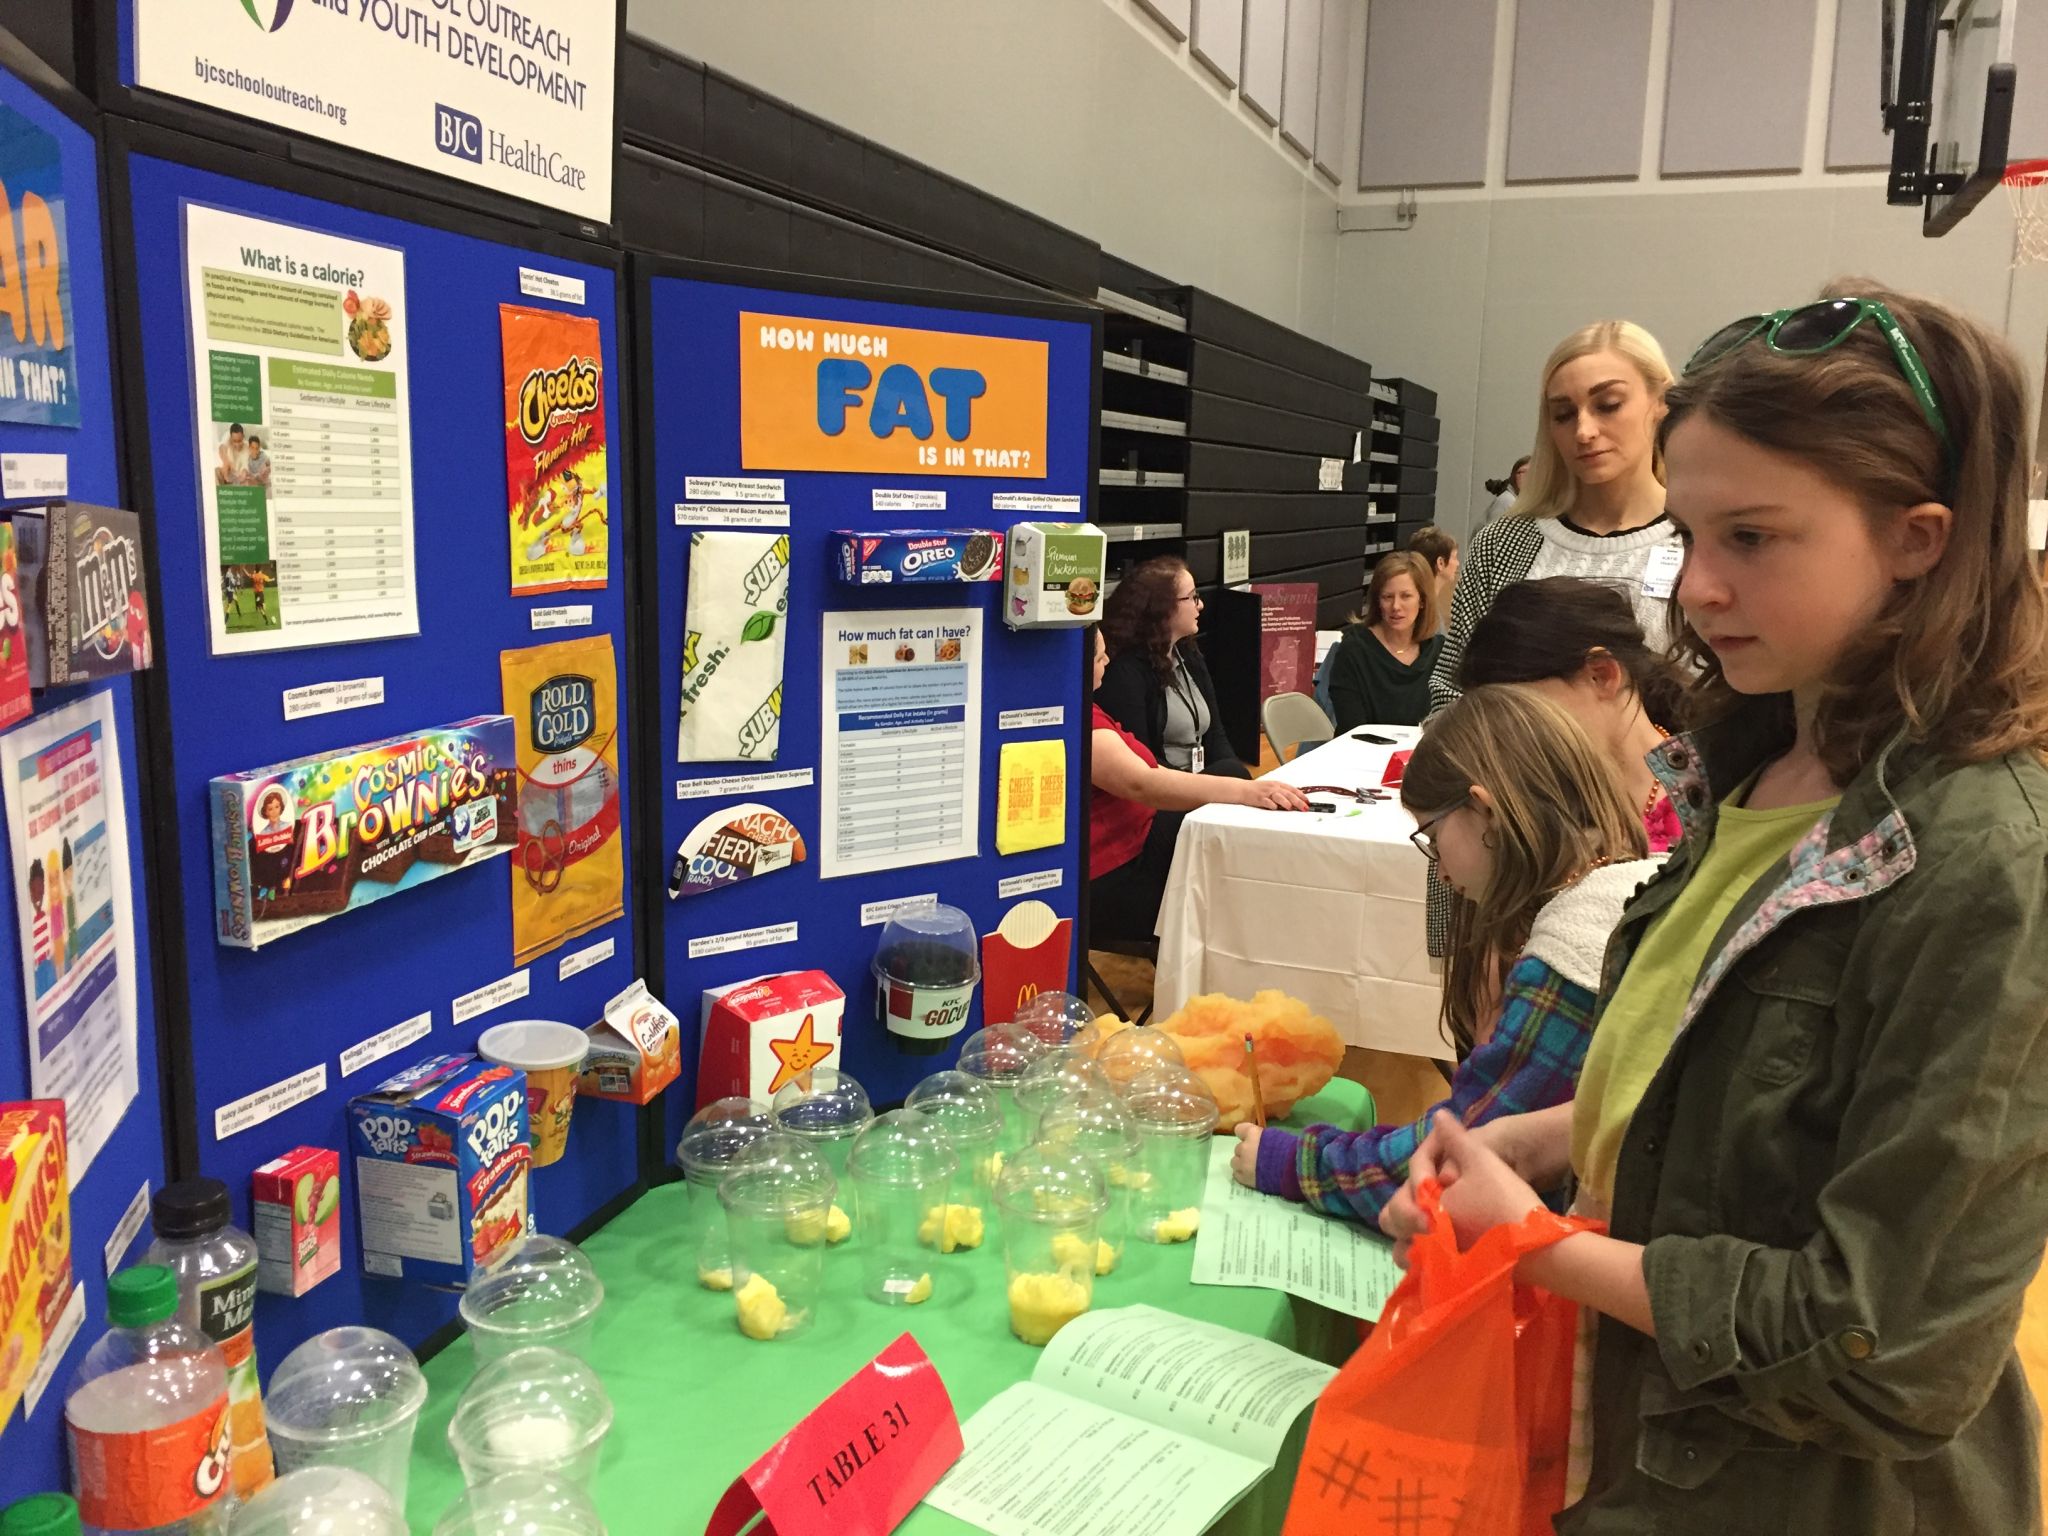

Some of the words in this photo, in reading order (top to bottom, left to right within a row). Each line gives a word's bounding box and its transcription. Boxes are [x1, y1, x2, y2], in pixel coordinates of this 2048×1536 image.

[467, 0, 571, 66] OUTREACH
[359, 0, 440, 53] YOUTH
[447, 25, 587, 111] DEVELOPMENT
[194, 56, 348, 126] bjcschooloutreach.org
[439, 110, 478, 156] BJC
[488, 128, 586, 191] HealthCare
[240, 246, 282, 274] What
[285, 255, 297, 276] is
[300, 263, 309, 277] a
[312, 263, 365, 288] calorie?
[760, 326, 814, 352] HOW
[823, 331, 888, 358] MUCH
[19, 359, 67, 406] THAT?
[520, 356, 597, 442] Cheetos
[817, 357, 987, 442] FAT
[571, 421, 592, 447] Hot
[919, 446, 938, 466] IS
[945, 447, 965, 467] IN
[973, 447, 1031, 469] THAT?
[689, 479, 710, 487] Subway
[720, 480, 737, 489] Turkey
[756, 483, 782, 491] Sandwich
[677, 505, 698, 513] Subway
[903, 547, 955, 570] OREO
[907, 540, 932, 551] Double
[932, 538, 947, 547] Stuf
[838, 629, 863, 642] How
[867, 628, 896, 640] much
[899, 627, 913, 640] fat
[916, 629, 934, 639] can
[942, 625, 971, 638] have?
[681, 647, 730, 704] fresh.
[308, 686, 335, 697] Brownies
[540, 681, 585, 713] ROLD
[538, 705, 589, 746] GOLD
[552, 758, 577, 775] thins
[679, 781, 691, 789] Taco
[721, 777, 740, 785] Cheese
[568, 825, 601, 855] Original
[734, 813, 801, 841] NACHO
[746, 831, 778, 844] CHEESE
[361, 838, 413, 873] CHOCOLATE
[413, 829, 428, 845] CHIP
[428, 821, 446, 836] CANDY
[702, 833, 763, 865] FIERY
[687, 874, 713, 885] RANCH
[688, 854, 739, 881] COOL
[367, 1039, 378, 1049] Pop
[221, 1109, 237, 1122] Juicy
[237, 1102, 253, 1114] Juice
[271, 1086, 287, 1098] Juice
[287, 1079, 302, 1091] Fruit
[302, 1071, 320, 1084] Punch
[450, 1079, 486, 1109] Strawberry
[411, 1151, 452, 1161] Strawberry
[477, 1148, 524, 1196] Strawberry
[527, 1213, 535, 1230] 8
[806, 1422, 886, 1508] TABLE
[882, 1400, 911, 1440] 31
